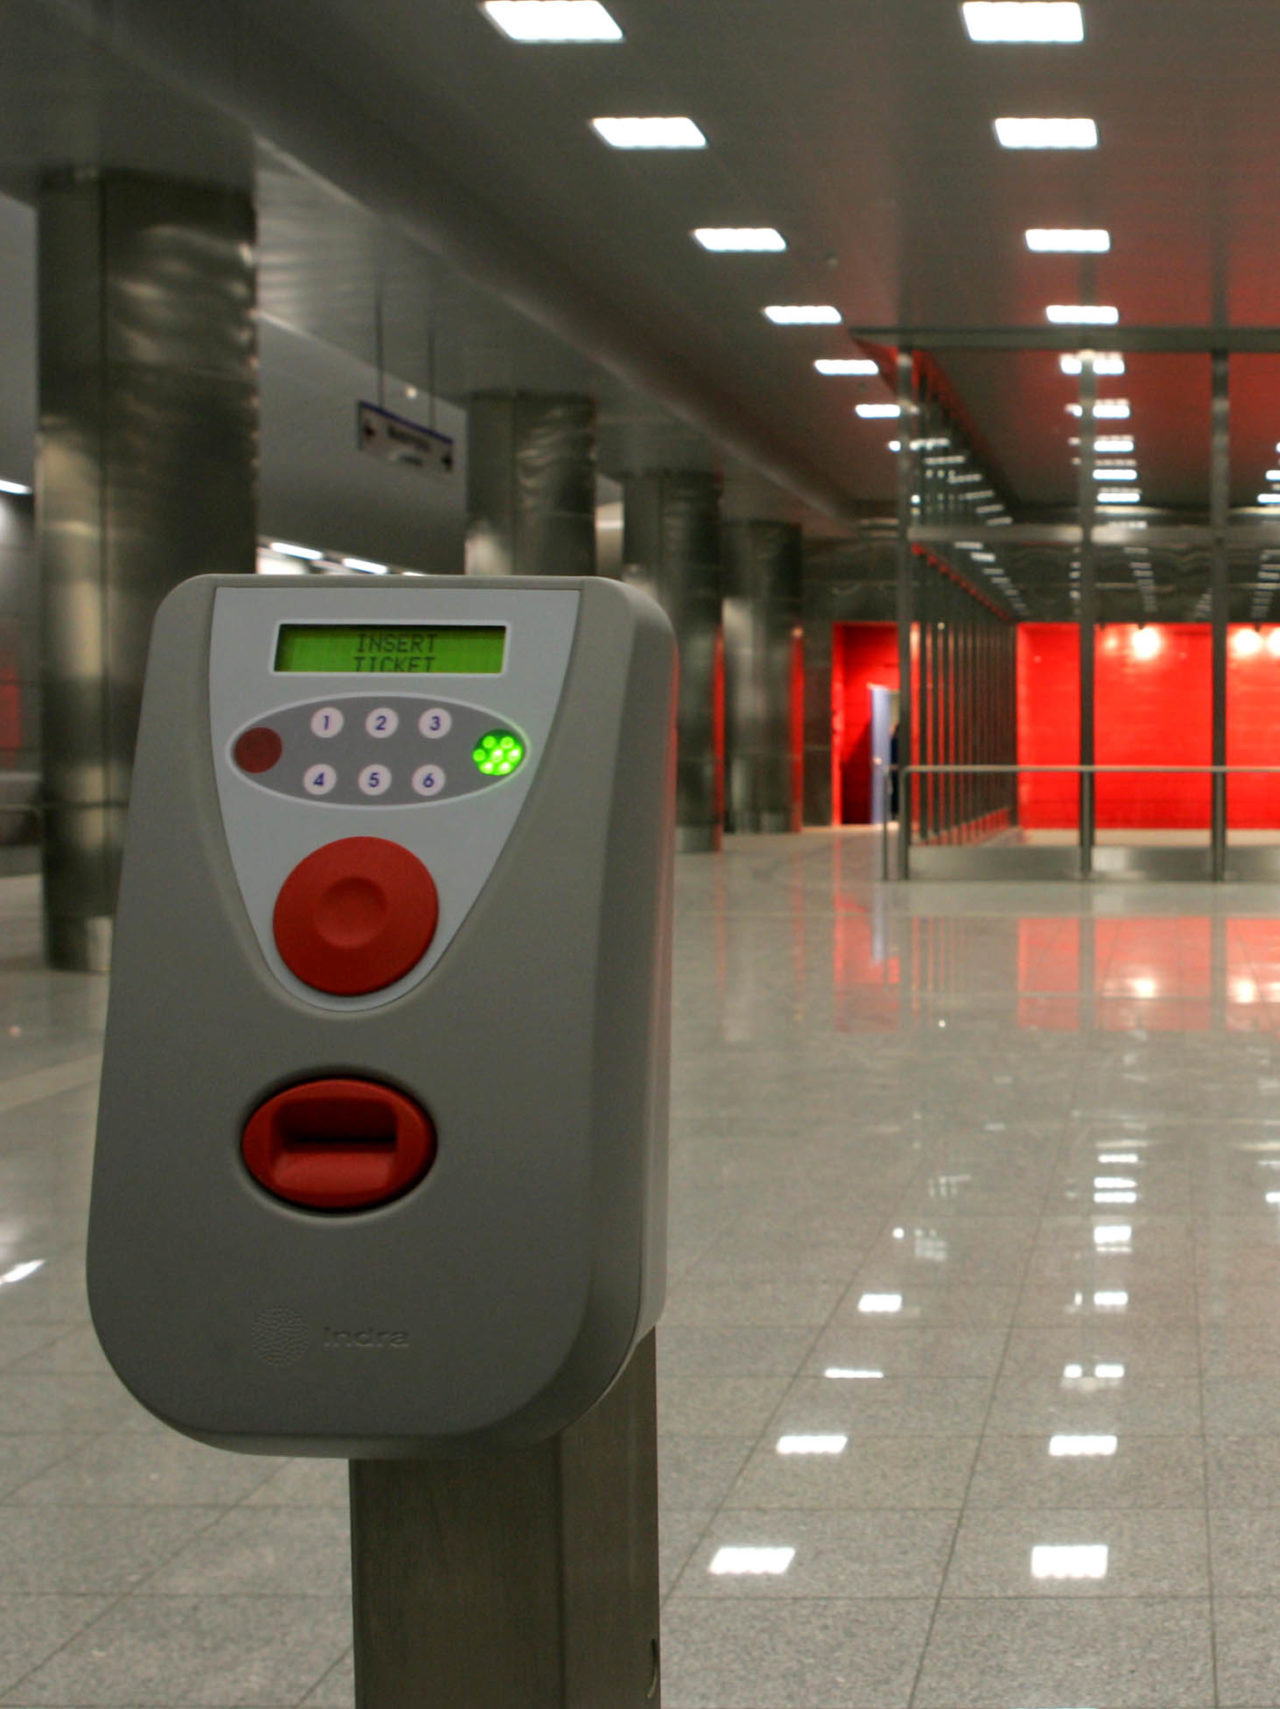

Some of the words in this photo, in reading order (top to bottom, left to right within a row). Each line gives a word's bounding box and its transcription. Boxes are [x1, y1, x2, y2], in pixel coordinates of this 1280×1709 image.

[357, 633, 438, 653] INSERT
[353, 656, 436, 673] TICKET
[323, 715, 330, 731] 1
[374, 715, 387, 731] 2
[429, 715, 441, 731] 3
[312, 772, 325, 787] 4
[368, 771, 380, 788] 5
[422, 772, 435, 788] 6
